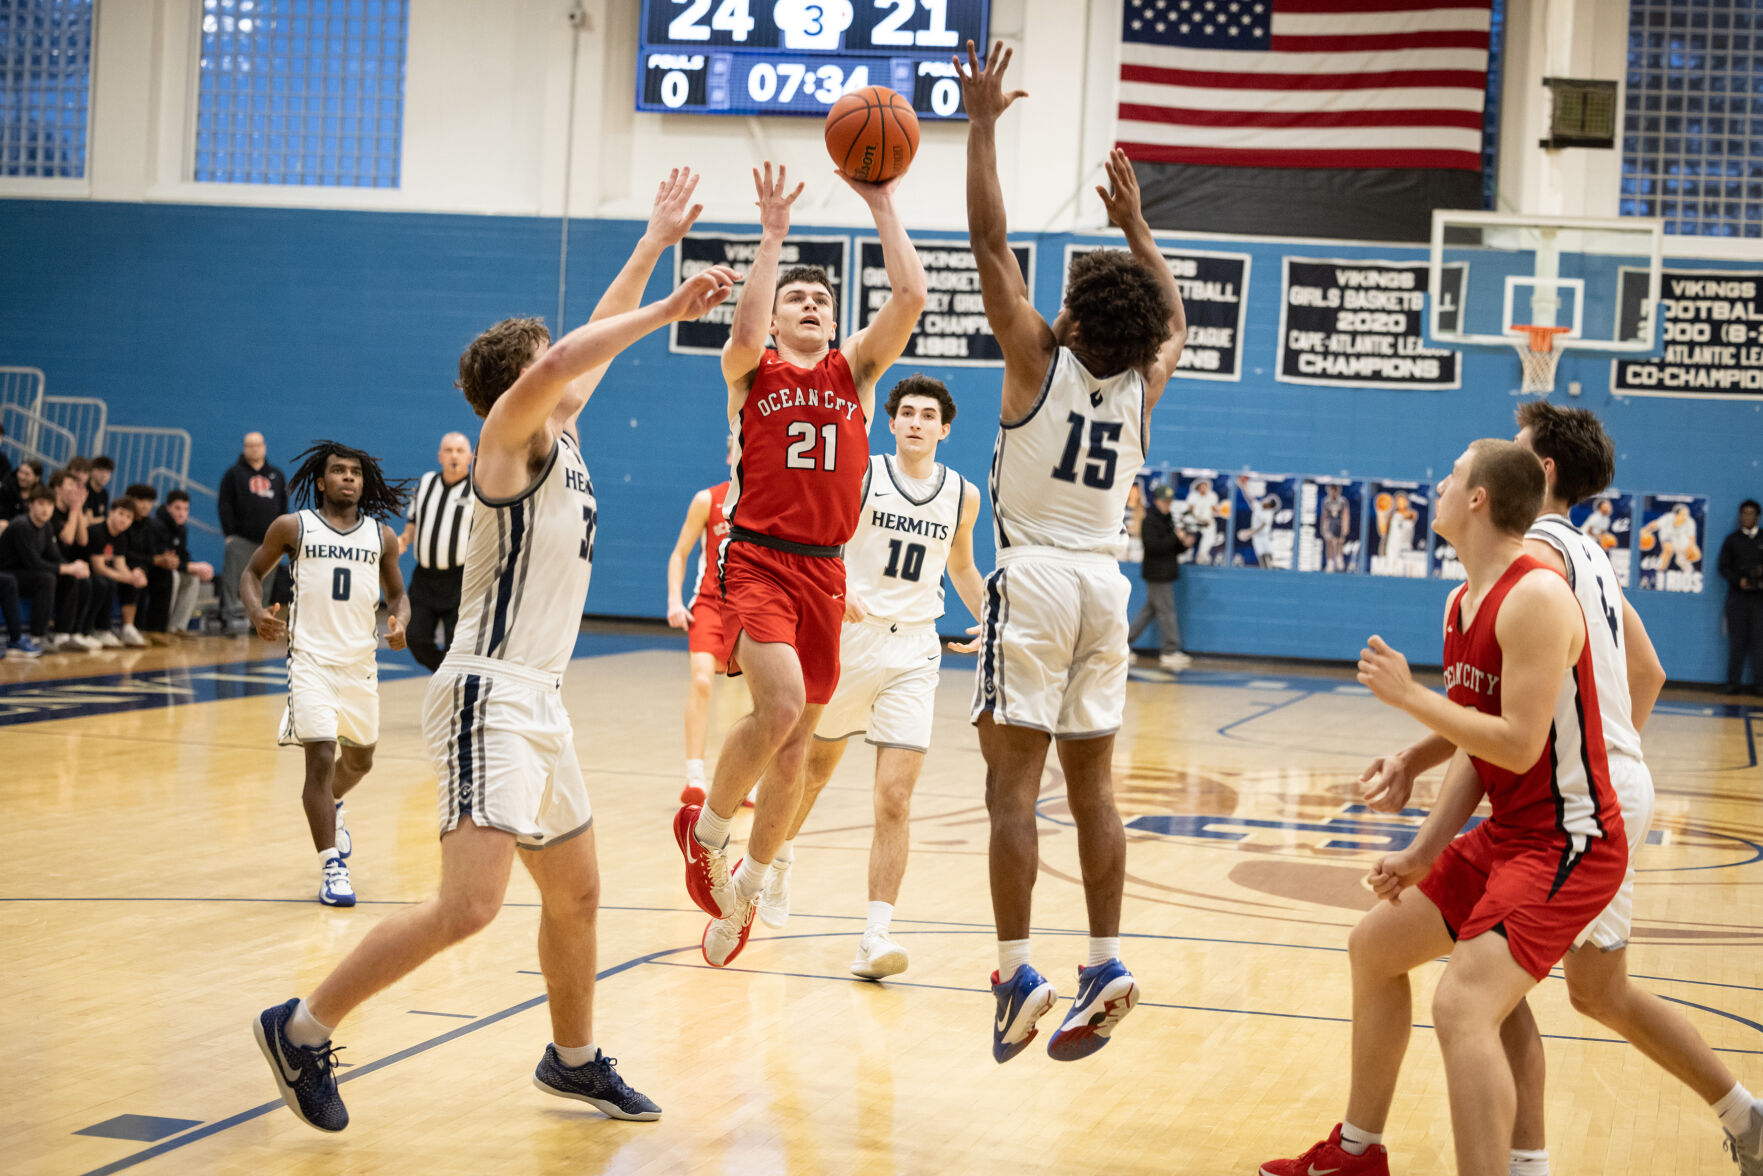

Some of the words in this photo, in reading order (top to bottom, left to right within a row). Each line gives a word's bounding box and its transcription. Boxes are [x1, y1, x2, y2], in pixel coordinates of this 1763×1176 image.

[669, 0, 754, 41] 24
[803, 5, 823, 36] 3
[871, 0, 958, 47] 21
[661, 70, 689, 109] 0
[748, 64, 869, 104] 07:34
[931, 78, 960, 117] 0
[1335, 268, 1416, 290] VIKINGS
[1671, 279, 1756, 298] VIKINGS
[1289, 285, 1342, 308] GIRLS
[1336, 311, 1407, 334] 2020
[1298, 352, 1440, 379] CHAMPIONS
[1625, 364, 1763, 389] CO-CHAMPIO
[757, 387, 819, 417] OCEAN
[786, 420, 838, 472] 21
[1050, 410, 1123, 491] 15
[872, 510, 948, 540] HERMITS
[305, 544, 377, 565] HERMITS
[883, 538, 926, 582] 10
[332, 567, 351, 601] 0
[1463, 663, 1499, 695] CITY
